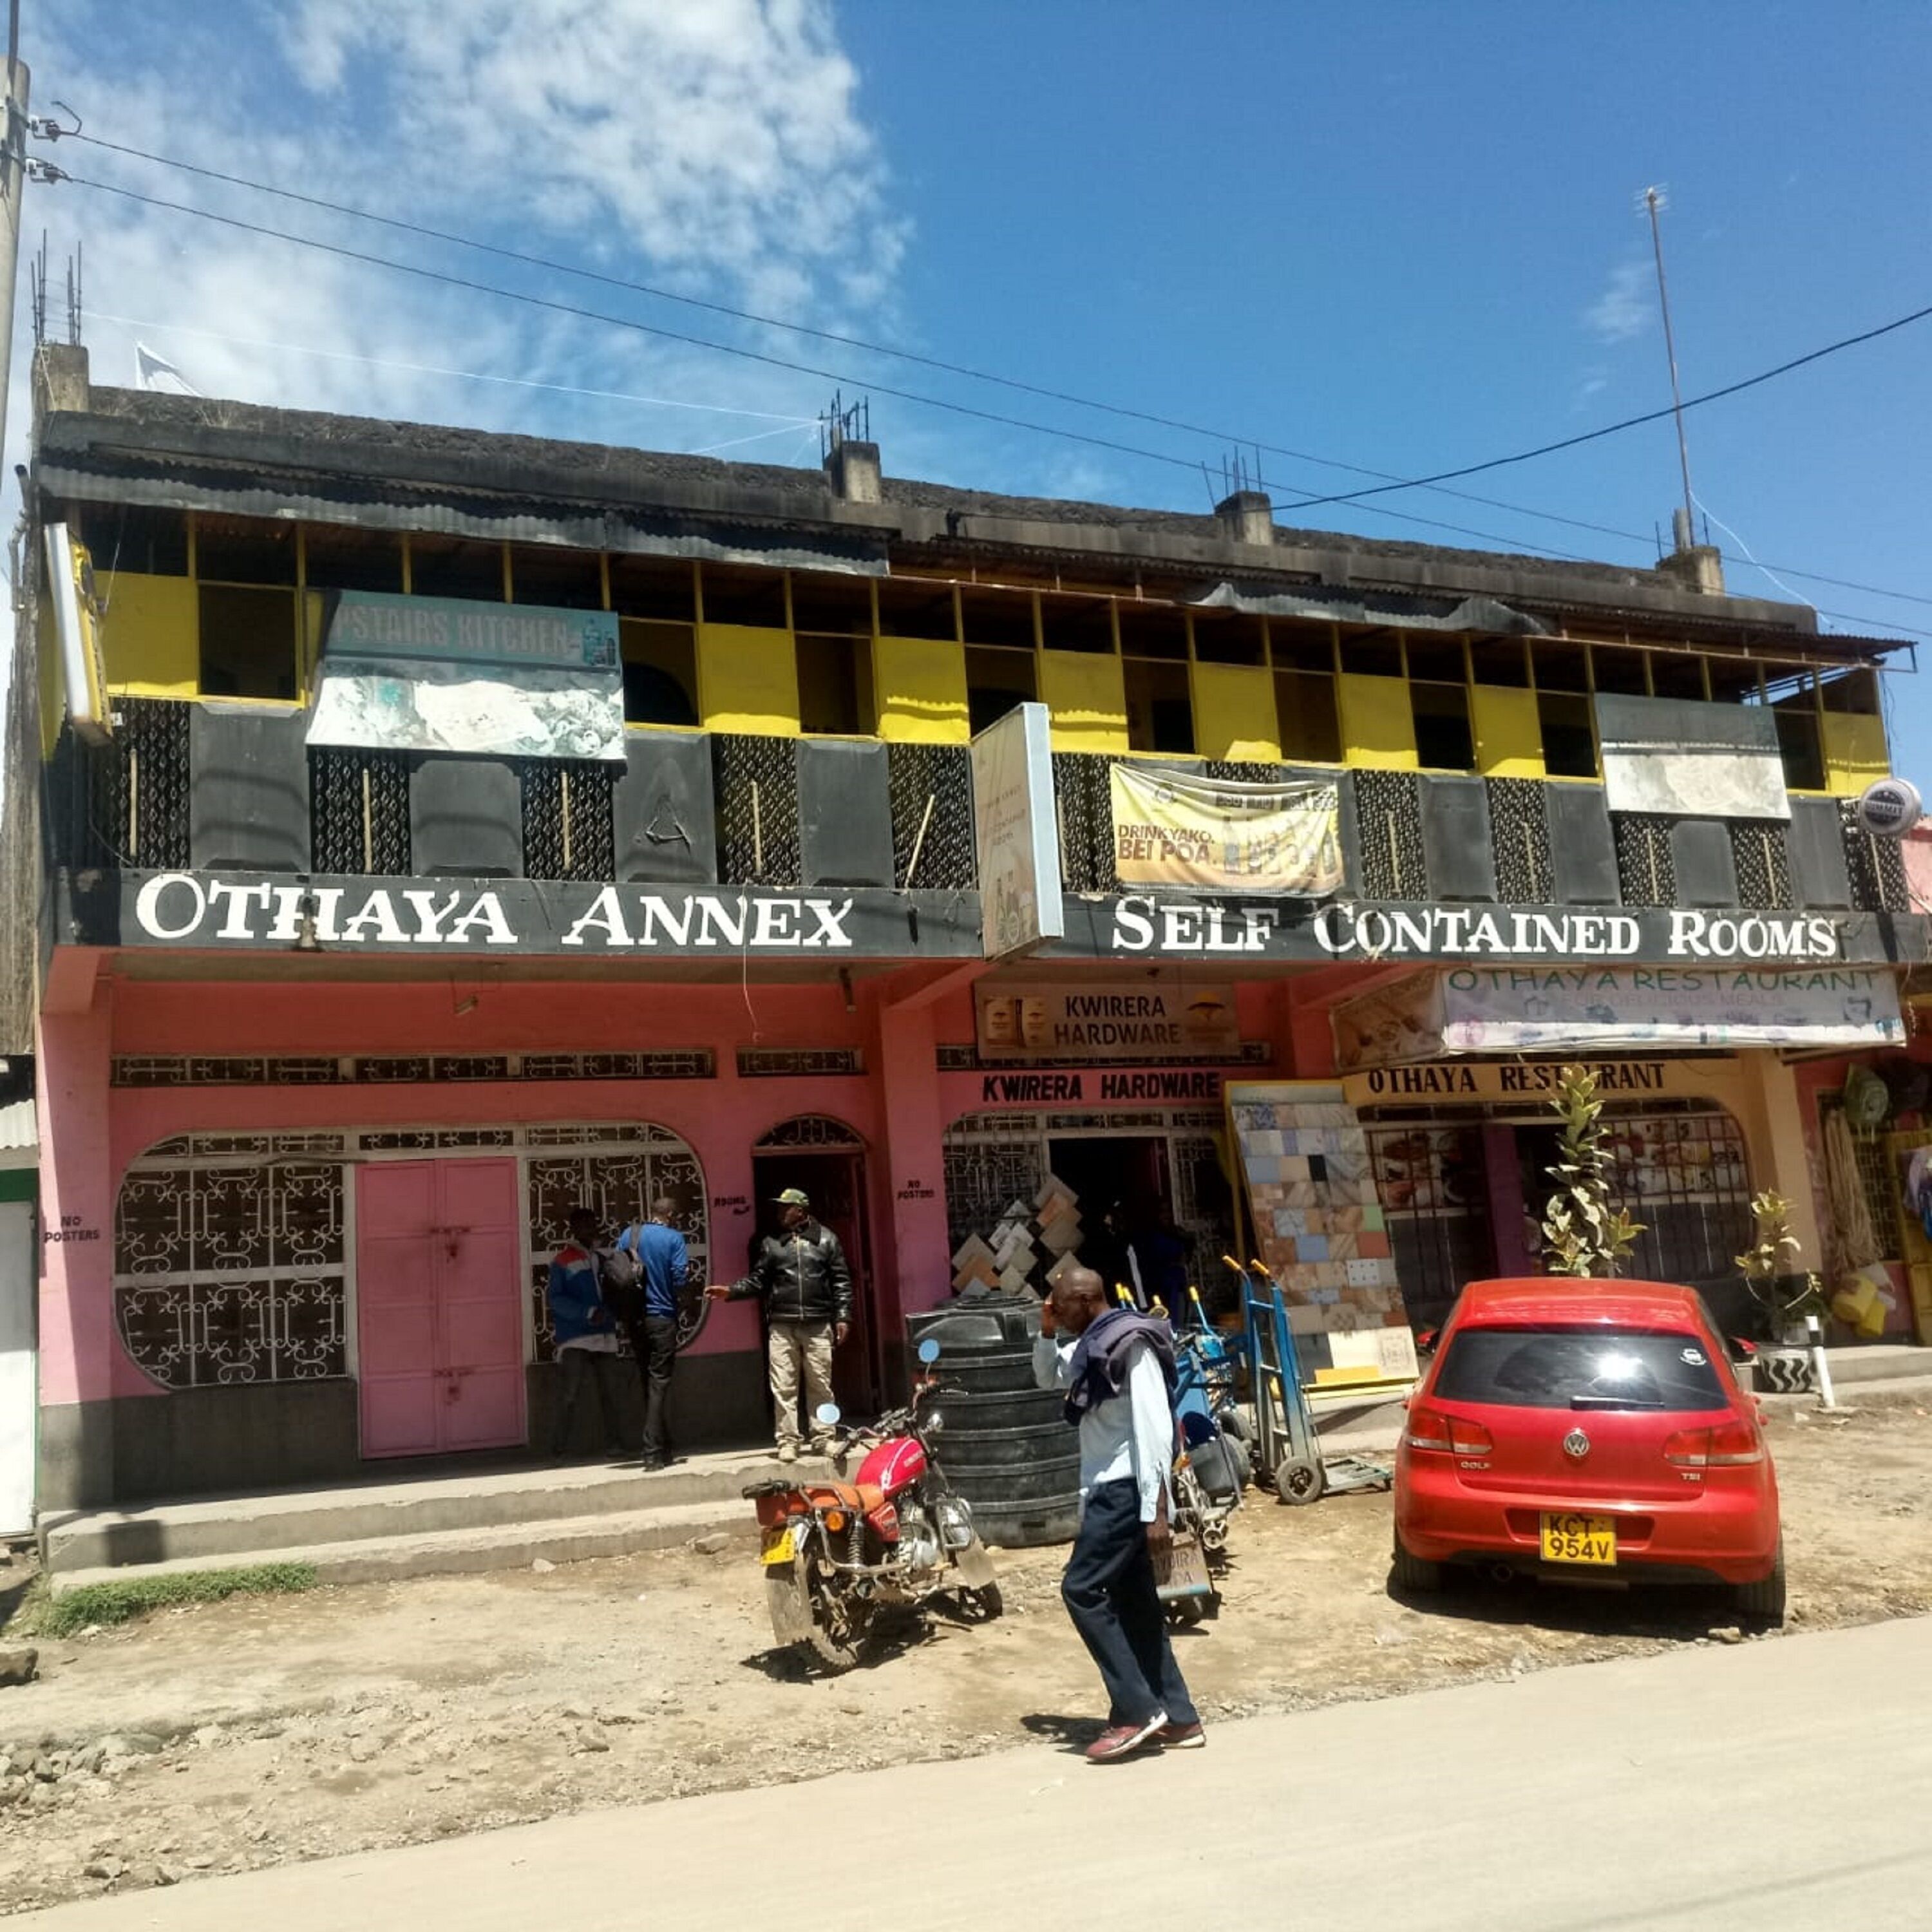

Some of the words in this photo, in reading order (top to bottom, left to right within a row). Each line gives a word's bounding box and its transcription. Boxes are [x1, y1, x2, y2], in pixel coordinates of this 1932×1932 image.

[457, 614, 568, 654] KITCHEN
[1118, 824, 1166, 840] DRINK
[1118, 839, 1153, 860] BEI
[136, 873, 518, 943] OTHAYA
[562, 886, 853, 947] ANNEX
[1112, 895, 1280, 951] SELF
[1313, 903, 1640, 954] CONTAINED
[1667, 911, 1837, 958] ROOMS
[1448, 970, 1619, 991] OTHAYA
[1633, 968, 1877, 991] RESTAURANT
[1065, 996, 1166, 1018] KWIRERA
[1054, 1023, 1182, 1046] HARDWARE
[983, 1074, 1083, 1102] KWIRERA
[1101, 1072, 1220, 1099] HARDWARE
[1368, 1066, 1477, 1094] OTHAYA
[1499, 1063, 1665, 1092] RESTRANT
[907, 1180, 920, 1189] NO
[61, 1216, 82, 1226] NO
[43, 1229, 100, 1243] POSTERS
[1549, 1515, 1594, 1538] KCT
[1549, 1537, 1609, 1559] 954V
